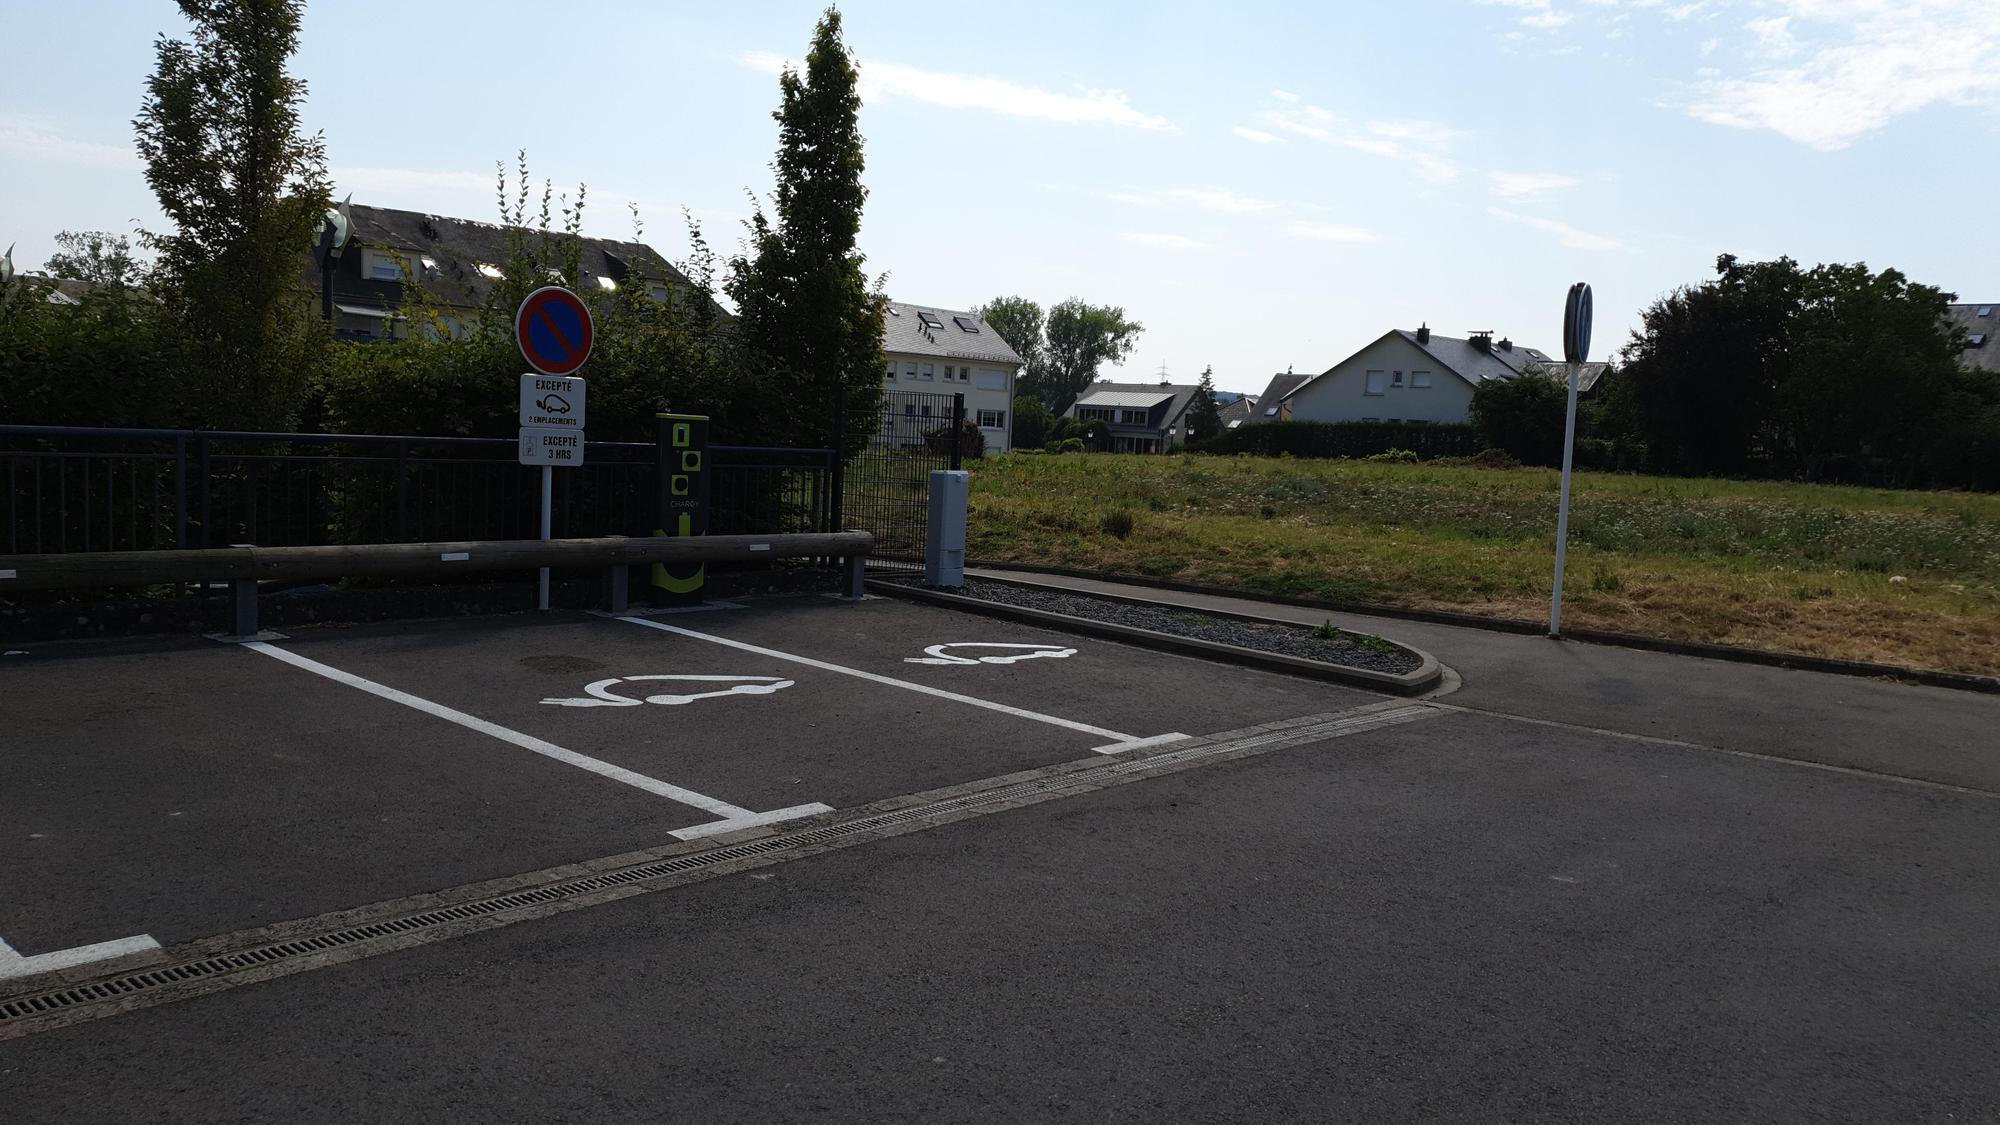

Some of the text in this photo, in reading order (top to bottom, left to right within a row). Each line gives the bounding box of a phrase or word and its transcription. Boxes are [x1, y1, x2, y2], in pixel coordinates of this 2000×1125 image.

[535, 379, 572, 392] EXCEPTÉ
[528, 415, 577, 426] 2 EMPLACEMENTS
[543, 435, 577, 447] EXCEPTÉ
[548, 449, 572, 460] 3 HRS
